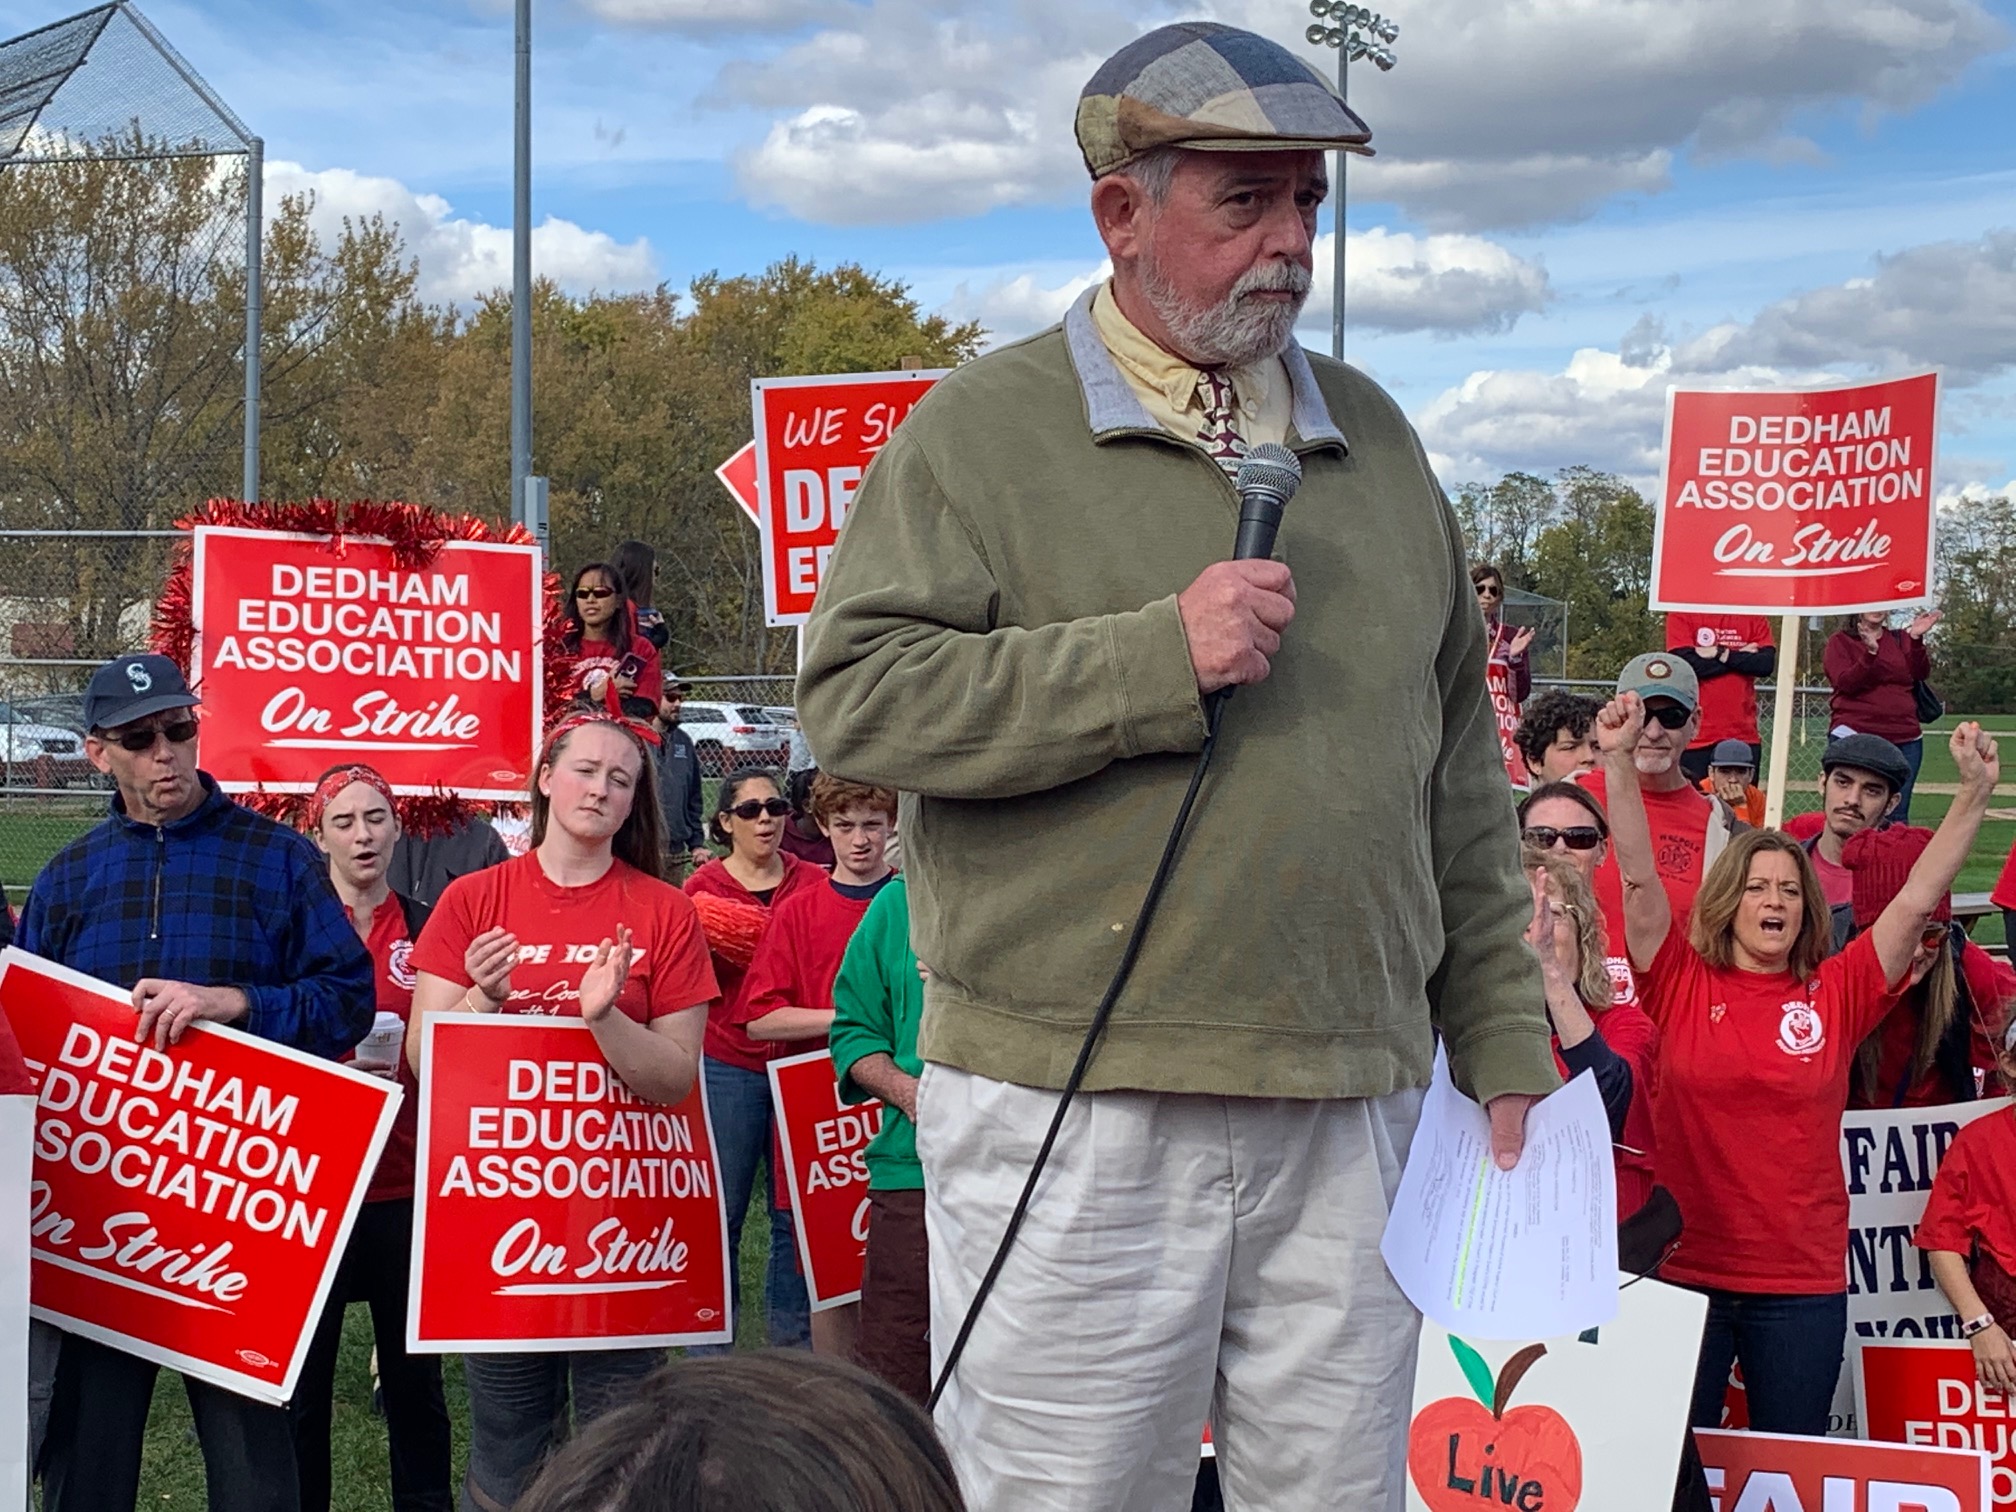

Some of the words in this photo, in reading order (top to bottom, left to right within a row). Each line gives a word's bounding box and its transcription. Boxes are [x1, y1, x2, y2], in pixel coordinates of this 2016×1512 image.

[783, 406, 848, 449] WE
[1730, 406, 1891, 445] DEDHAM
[1698, 436, 1911, 478] EDUCATION
[1675, 468, 1923, 512] ASSOCIATION
[1713, 523, 1775, 564] On
[1781, 517, 1892, 566] Strike
[271, 562, 469, 607] DEDHAM
[237, 598, 501, 645] EDUCATION
[212, 635, 521, 684] ASSOCIATION
[260, 685, 332, 735] On
[339, 690, 480, 741] Strike
[59, 1022, 300, 1137] DEDHAM
[508, 1059, 668, 1108] DEDH
[468, 1107, 694, 1153] EDUCATION
[33, 1118, 329, 1249] SOCIATION
[439, 1155, 712, 1200] ASSOCIATION
[79, 1212, 249, 1302] Strike
[490, 1218, 568, 1277] On
[574, 1216, 689, 1278] Strike
[1446, 1432, 1545, 1512] Live
